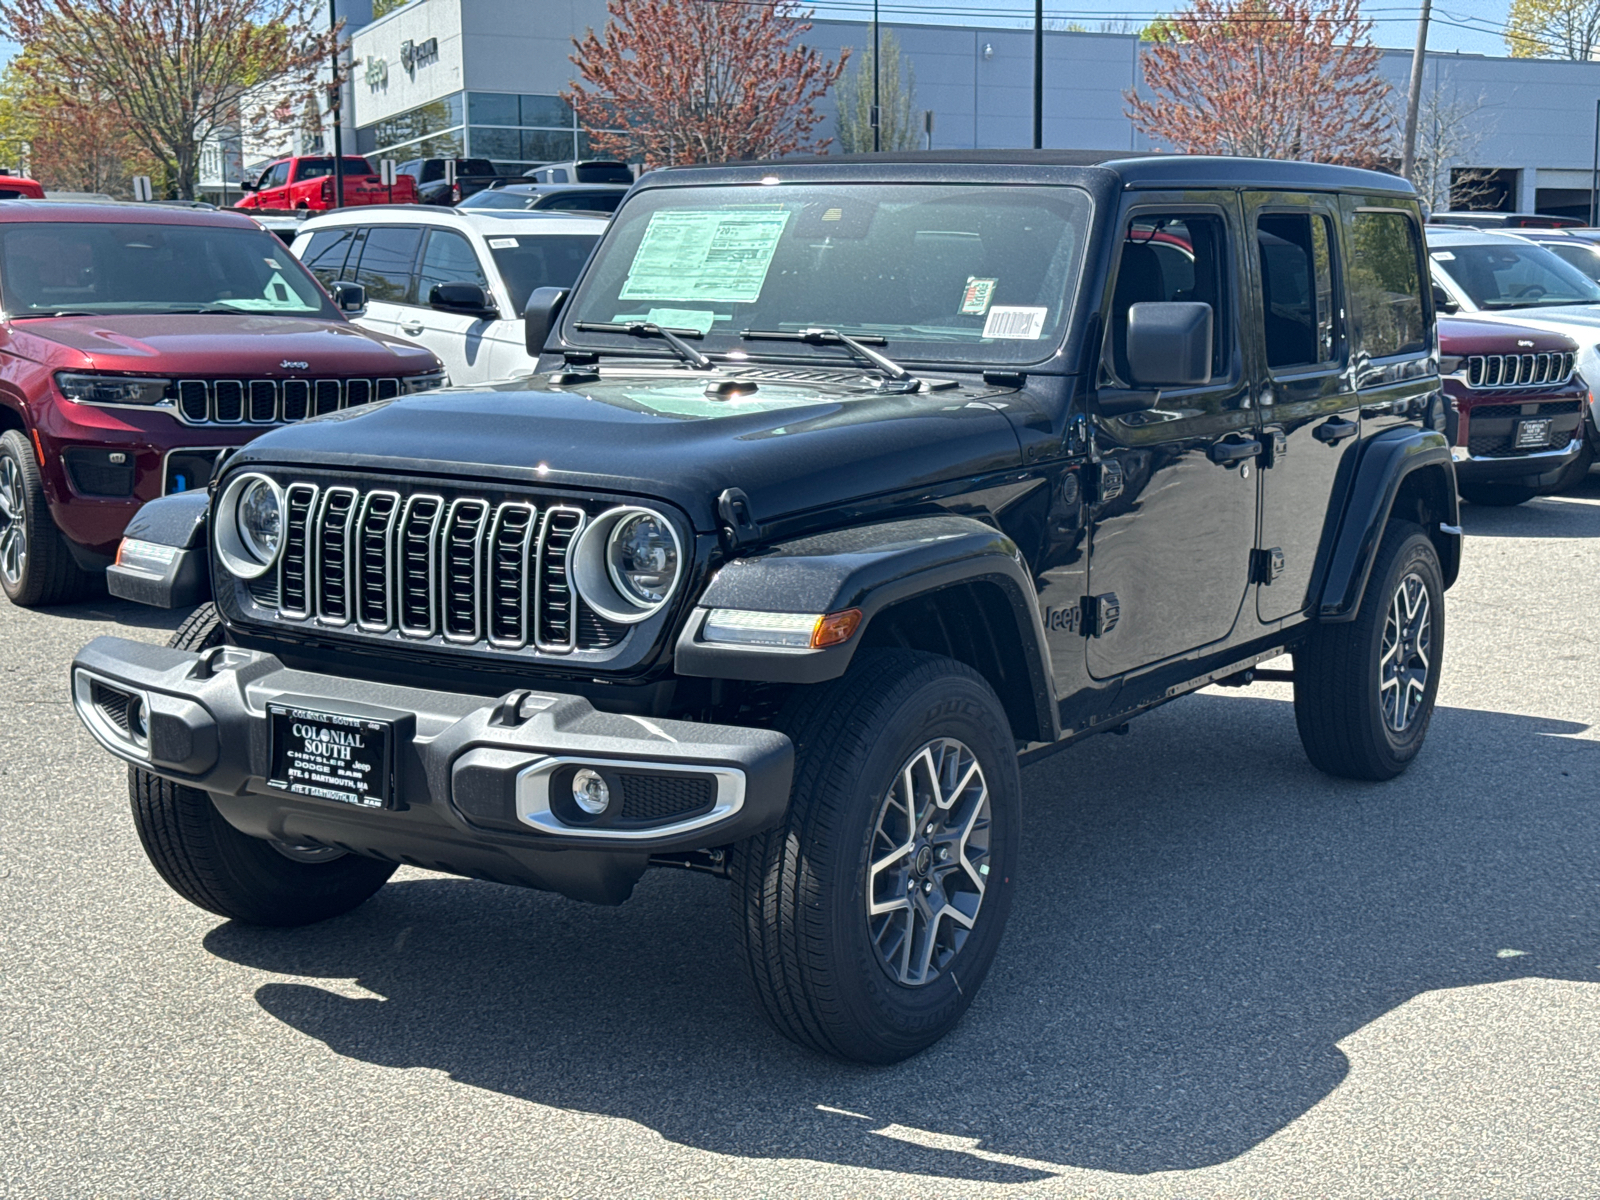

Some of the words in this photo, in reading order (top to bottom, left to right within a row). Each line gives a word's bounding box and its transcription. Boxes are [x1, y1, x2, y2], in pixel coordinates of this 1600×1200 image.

[279, 359, 309, 370] Jeep
[1043, 604, 1082, 632] Jeep
[292, 709, 329, 723] COLONIAL
[332, 715, 360, 728] SOUTH
[292, 723, 365, 748] COLONIAL
[287, 750, 345, 767] CHRYSLER
[304, 739, 352, 760] SOUTH
[294, 760, 331, 774] DODGE
[337, 769, 362, 779] RAM
[352, 760, 371, 772] Jeep
[357, 781, 369, 790] MA
[349, 794, 359, 804] MA
